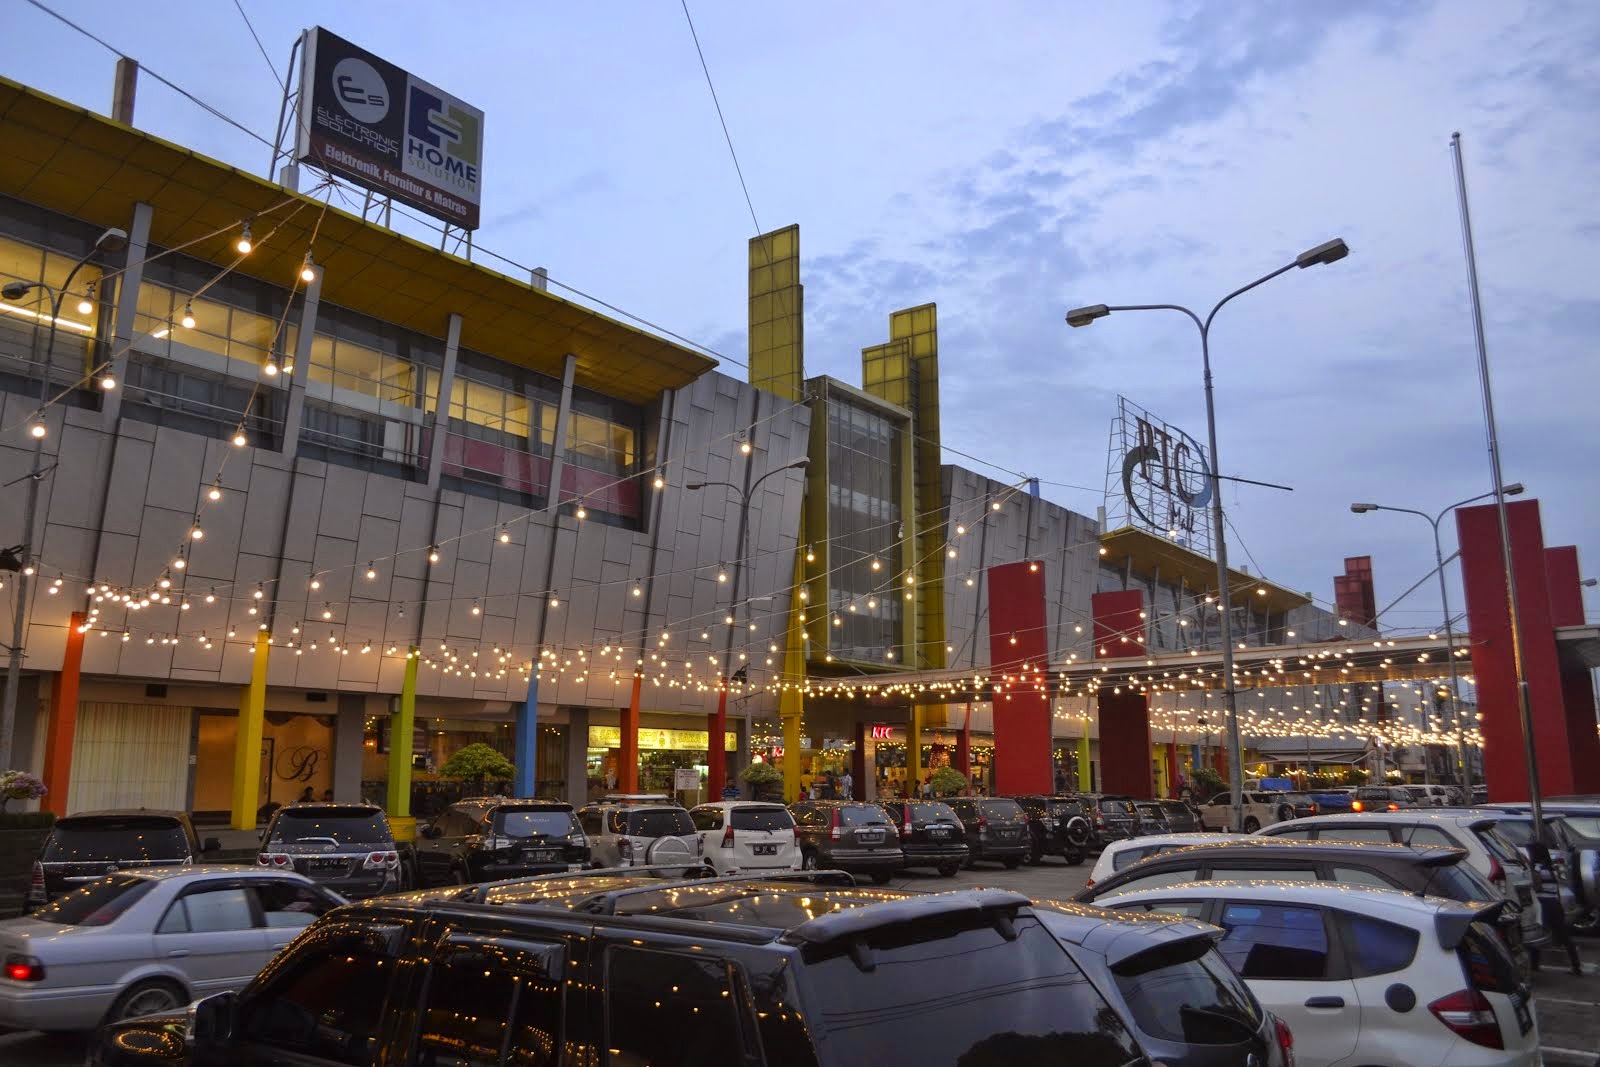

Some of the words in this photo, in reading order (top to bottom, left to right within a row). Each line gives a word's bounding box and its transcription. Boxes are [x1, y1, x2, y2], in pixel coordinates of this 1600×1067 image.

[317, 106, 400, 150] ELECTRONIC
[324, 143, 382, 180] Elektronik,
[383, 169, 425, 199] Furnitur
[424, 188, 433, 200] &
[433, 191, 468, 216] Matras
[408, 138, 477, 184] HOME
[408, 155, 476, 193] SOLUTION
[1135, 416, 1194, 506] PTC
[872, 726, 894, 739] KFC
